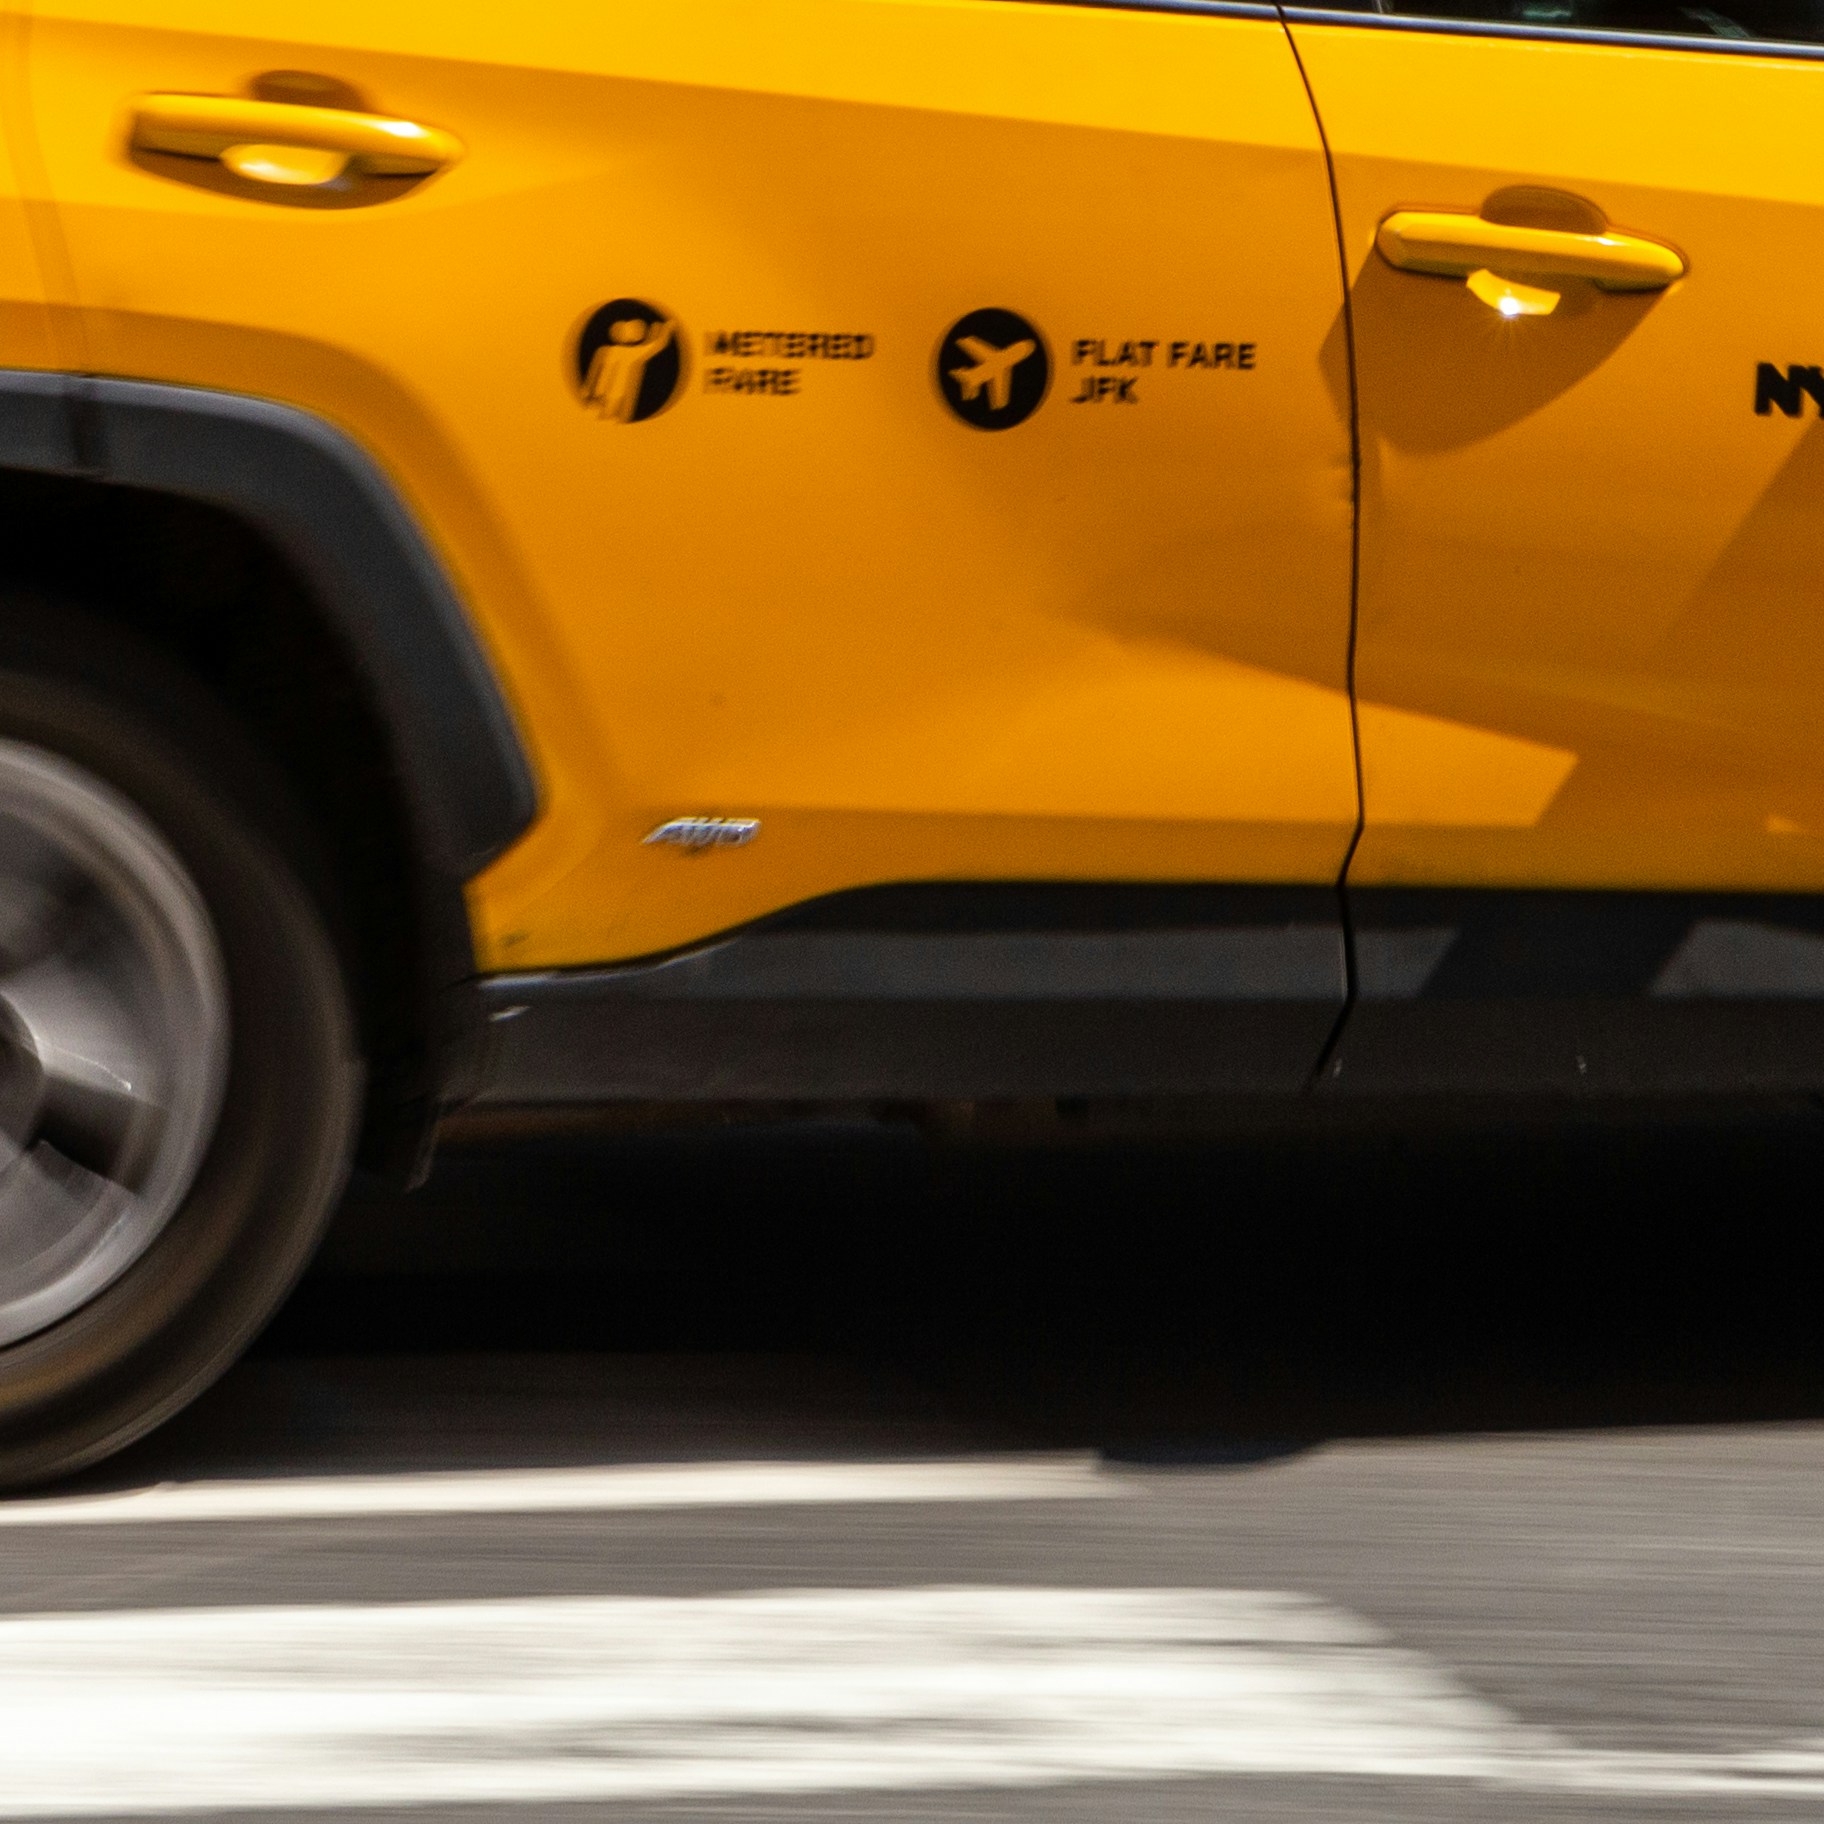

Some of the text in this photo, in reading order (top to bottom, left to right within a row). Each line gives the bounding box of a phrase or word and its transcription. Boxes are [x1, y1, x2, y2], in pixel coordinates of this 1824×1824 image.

[702, 330, 875, 361] METERED
[1071, 338, 1258, 371] FLAT FARE
[702, 367, 802, 396] FARE
[1069, 375, 1140, 405] JFK
